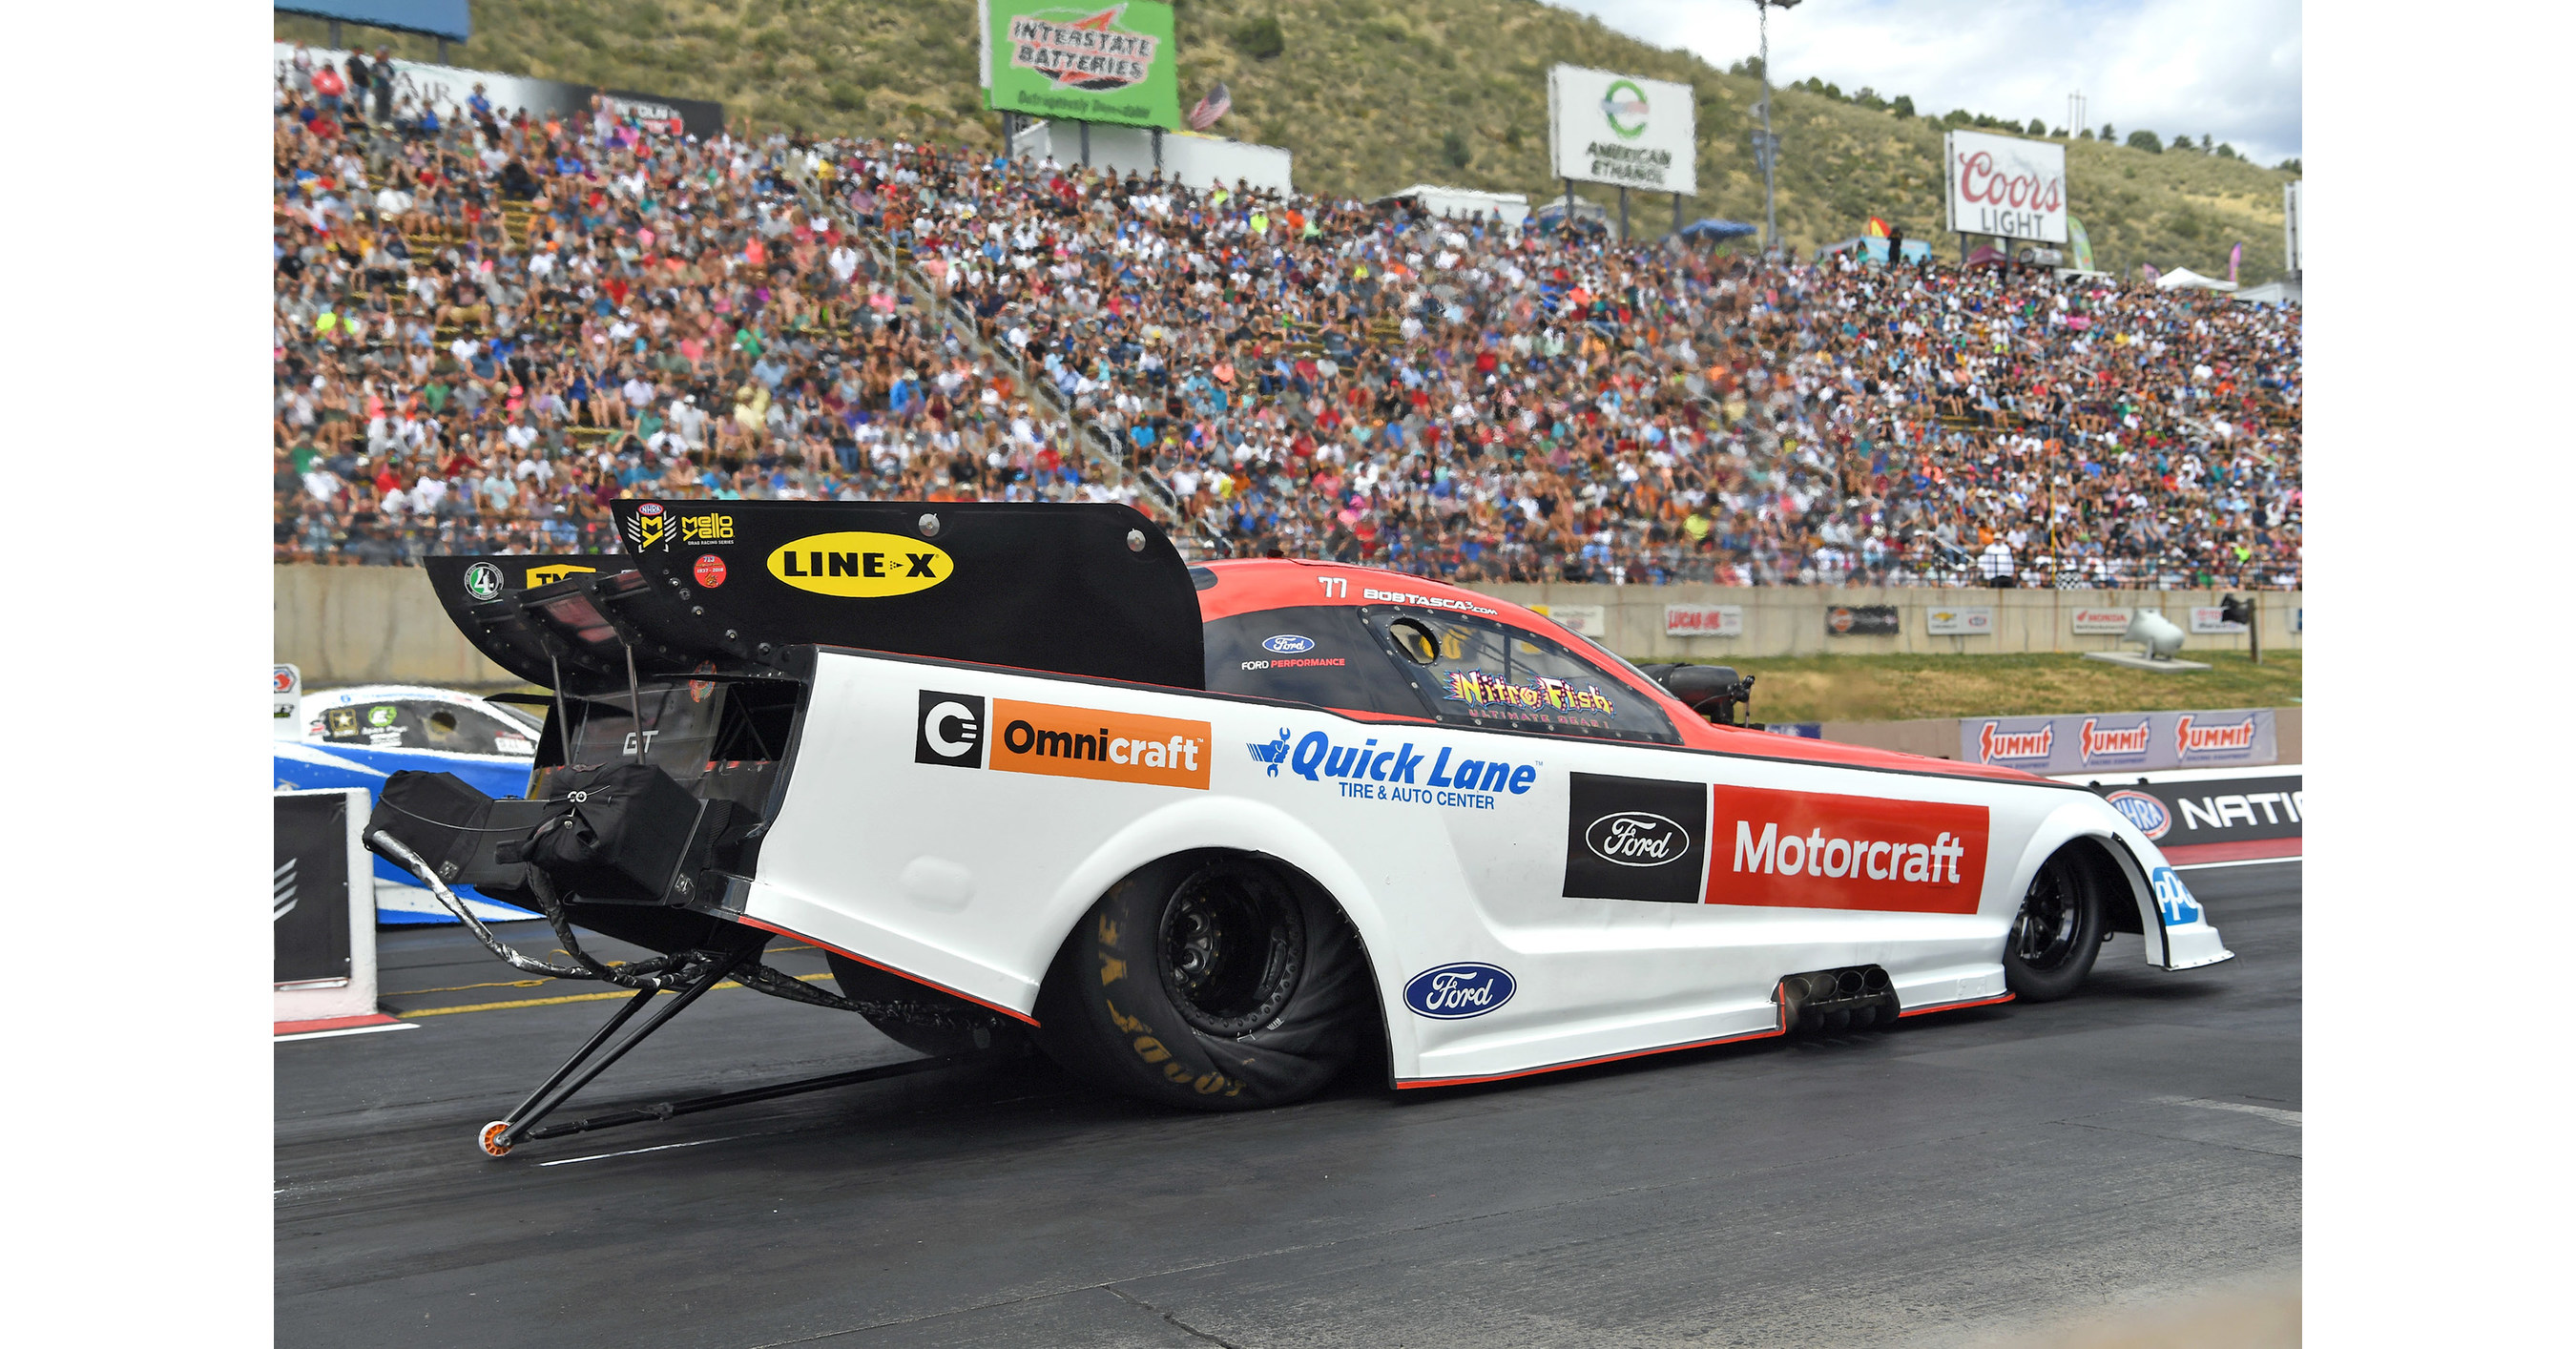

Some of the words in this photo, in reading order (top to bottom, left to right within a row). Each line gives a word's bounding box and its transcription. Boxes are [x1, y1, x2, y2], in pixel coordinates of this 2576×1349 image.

[1012, 20, 1153, 57] INTERSTATE
[1017, 44, 1144, 80] BATTERIES
[1586, 141, 1672, 169] AMERICAN
[1959, 151, 2062, 213] Coors
[1981, 208, 2044, 238] LIGHT
[1318, 576, 1347, 598] 77
[1272, 635, 1306, 652] Ford
[1241, 660, 1270, 671] FORD
[1270, 657, 1345, 669] PERFORMANCE
[1452, 670, 1540, 710] Nitro
[1538, 674, 1614, 717] Fish
[1468, 709, 1551, 723] ULTIMATE
[623, 730, 659, 756] GT
[1004, 719, 1198, 772] Omnicraft
[1981, 723, 2050, 762] SUMMIT
[2082, 721, 2148, 758] SUMMIT
[2178, 717, 2251, 752] SUMMIT
[1291, 731, 1425, 784] Quick
[1426, 746, 1537, 796] Lane
[1339, 782, 1374, 799] TIRE
[1378, 785, 1387, 799] &
[1391, 786, 1433, 804] AUTO
[1437, 791, 1495, 810] CENTER
[1603, 818, 1673, 860] Ford
[1733, 820, 1964, 884] Motorcraft
[1425, 971, 1494, 1009] Ford
